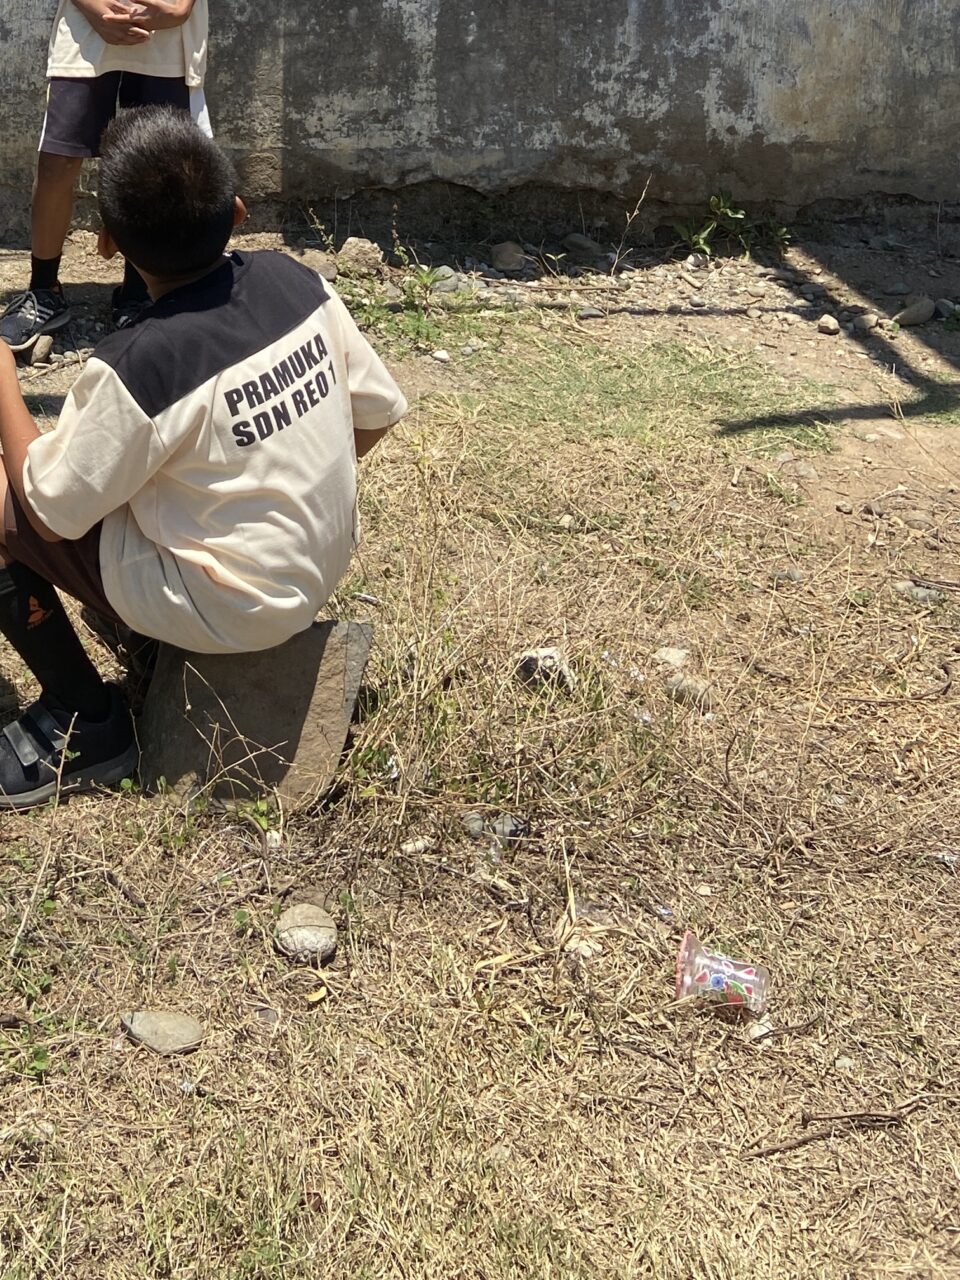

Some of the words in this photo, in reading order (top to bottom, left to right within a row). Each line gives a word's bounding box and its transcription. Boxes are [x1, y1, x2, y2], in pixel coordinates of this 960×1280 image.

[223, 333, 328, 418] PRAMUKA
[231, 400, 293, 448] SDN
[291, 370, 330, 419] REO
[327, 359, 337, 386] 1
